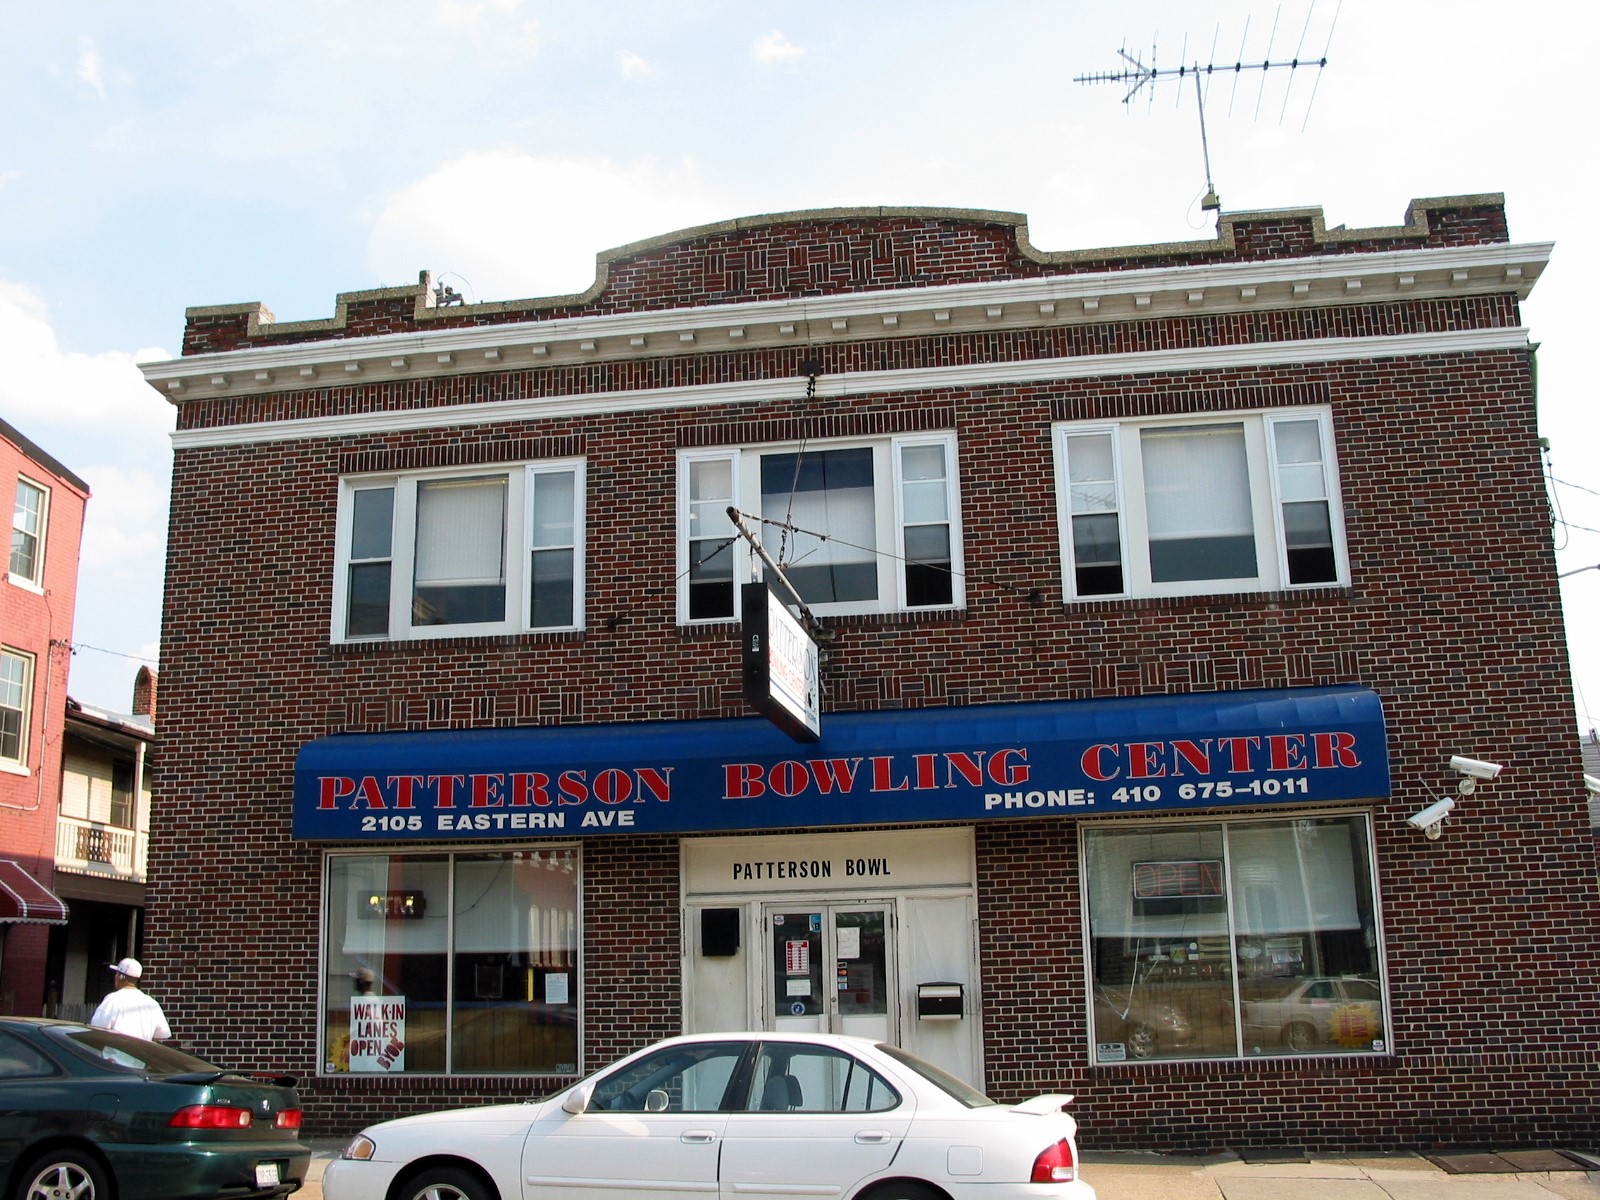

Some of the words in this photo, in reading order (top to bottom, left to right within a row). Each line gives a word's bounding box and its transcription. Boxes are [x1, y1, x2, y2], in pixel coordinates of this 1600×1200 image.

[316, 767, 674, 810] PATTERSON
[722, 748, 1031, 799] BOWLING
[1080, 731, 1362, 782] CENTER
[984, 789, 1096, 810] PHONE:
[1111, 785, 1161, 803] 410
[1178, 777, 1309, 799] 675-1011
[361, 815, 423, 832] 2105
[437, 812, 566, 831] EASTERN
[581, 810, 635, 827] AVE
[733, 860, 832, 880] PATTERSON
[845, 858, 891, 876] BOWL
[1136, 863, 1222, 896] OPEN
[357, 1021, 398, 1038] LANES
[350, 1039, 382, 1057] OPEN
[376, 1037, 405, 1071] BYOB
